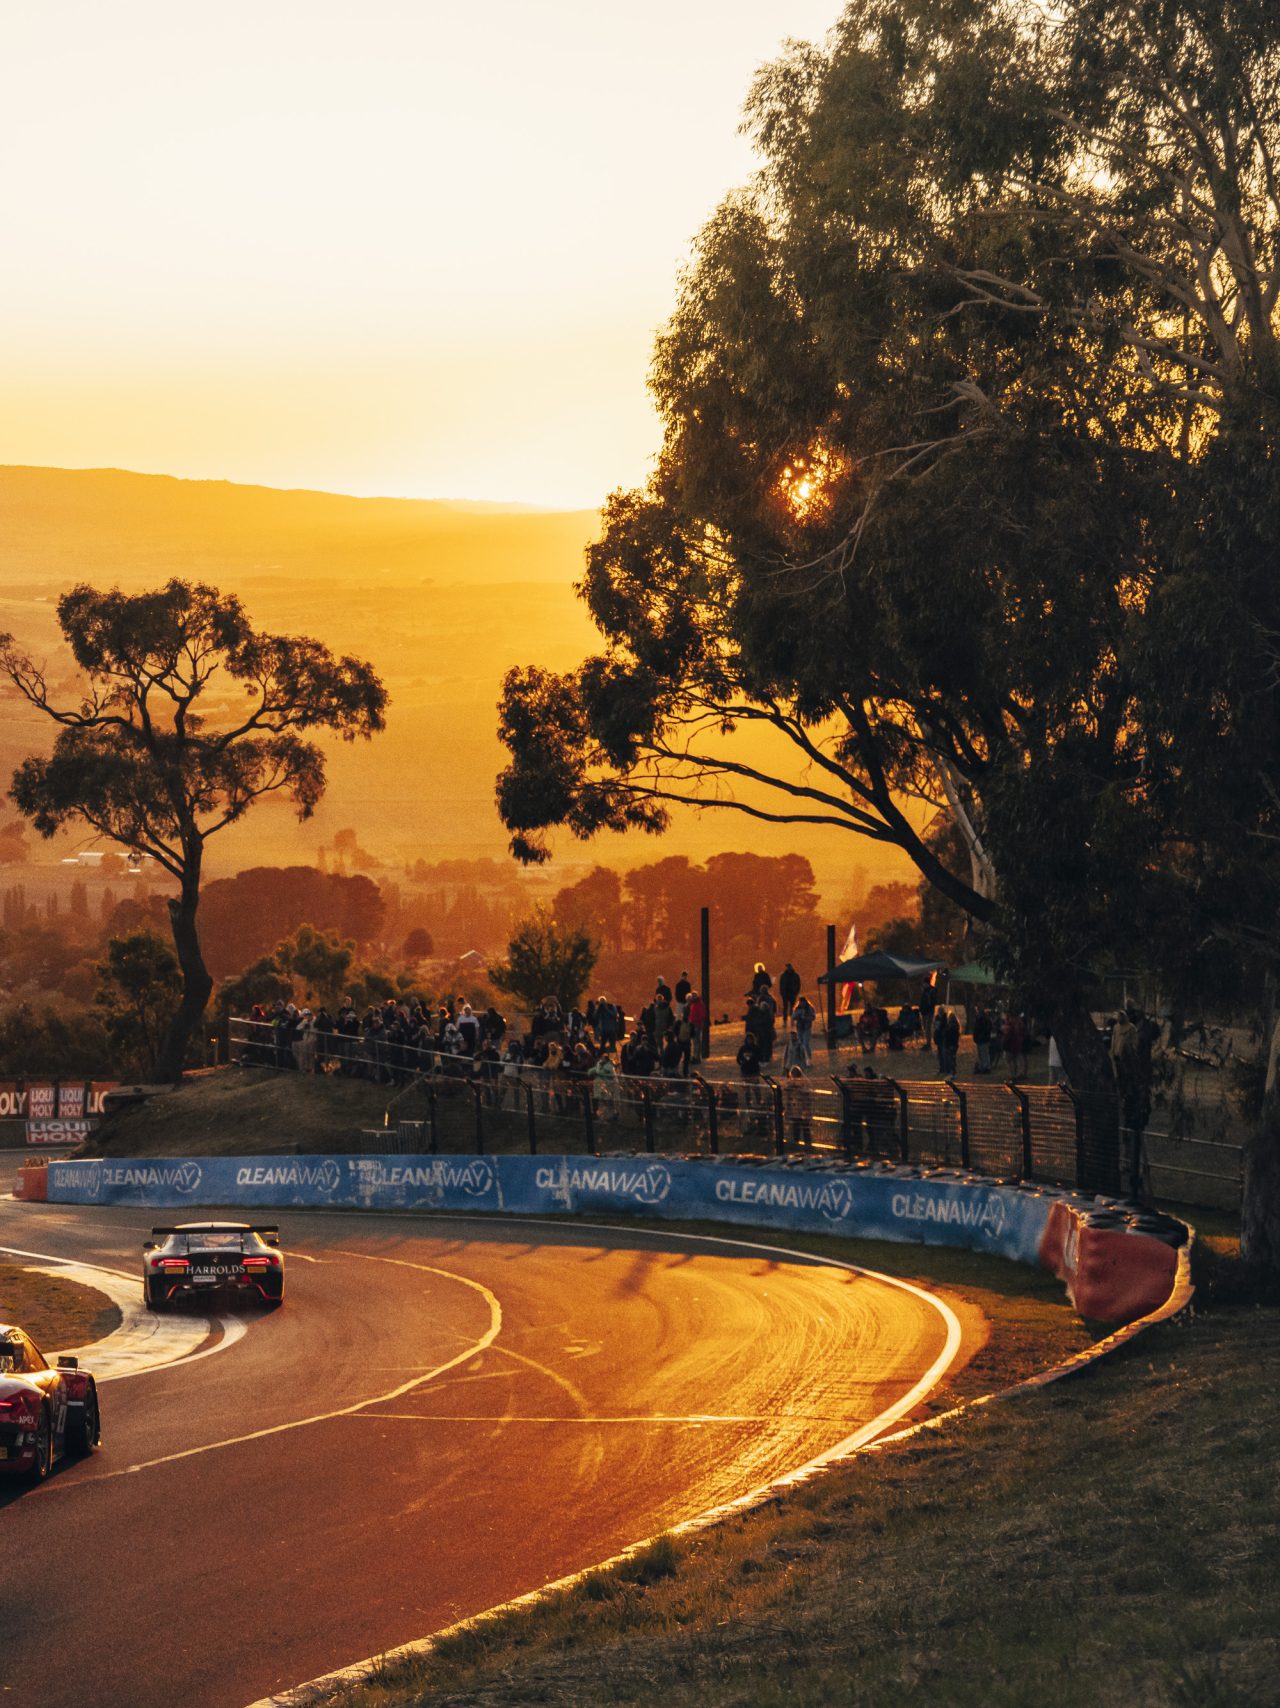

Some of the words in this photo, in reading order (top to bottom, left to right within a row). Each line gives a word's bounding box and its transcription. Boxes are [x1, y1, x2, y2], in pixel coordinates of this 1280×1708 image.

[31, 1089, 54, 1102] LIQUI
[59, 1089, 83, 1102] LIQUI
[30, 1104, 53, 1117] MOLY
[58, 1103, 82, 1117] MOLY
[29, 1121, 87, 1132] LIQUI
[31, 1132, 88, 1142] MOLY
[55, 1168, 98, 1188] CLEANAWAY
[103, 1167, 196, 1185] CLEANAWAY
[237, 1167, 334, 1185] CLEANAWAY
[372, 1167, 485, 1187] CLEANAWAY
[716, 1179, 845, 1210] CLEANAWAY
[186, 1265, 245, 1276] HARROLDS
